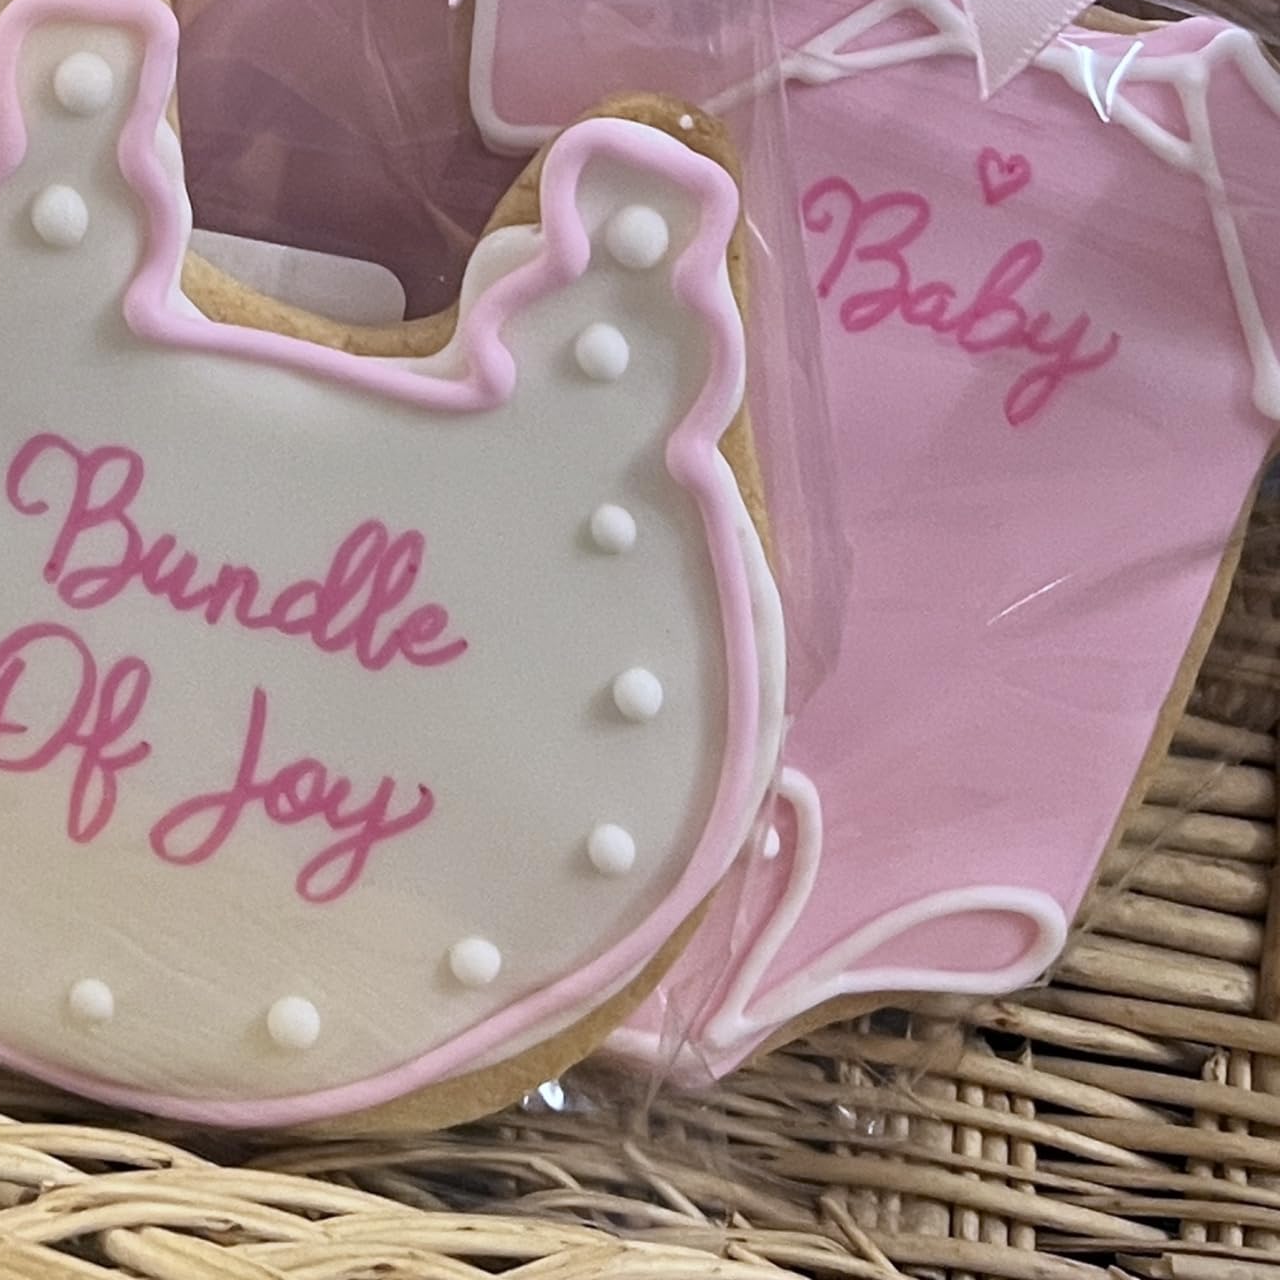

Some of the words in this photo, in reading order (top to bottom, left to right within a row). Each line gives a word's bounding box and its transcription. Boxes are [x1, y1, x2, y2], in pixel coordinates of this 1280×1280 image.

[801, 176, 1121, 428] Baby
[5, 431, 469, 672] Bundle
[148, 686, 436, 905] Joy
